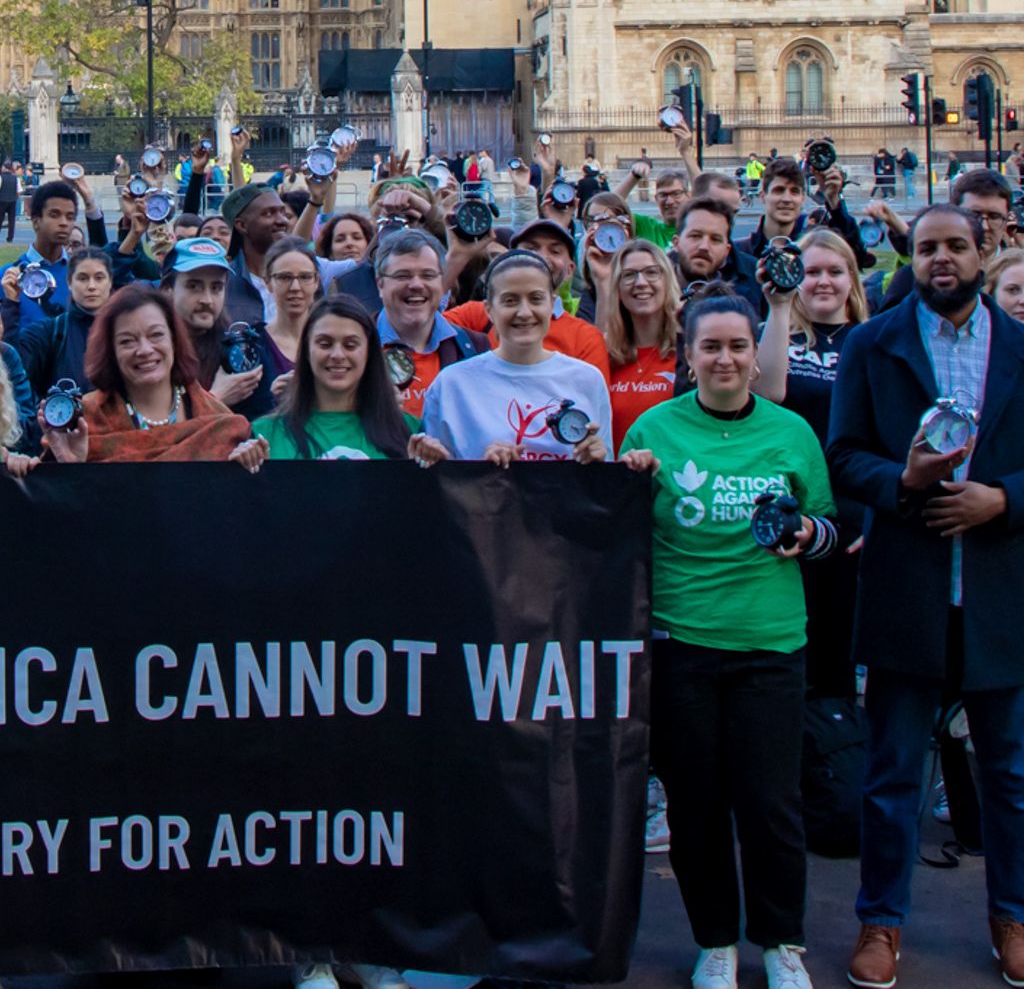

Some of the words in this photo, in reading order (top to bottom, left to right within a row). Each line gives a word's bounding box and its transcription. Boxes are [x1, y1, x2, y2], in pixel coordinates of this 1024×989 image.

[787, 345, 839, 368] CAF
[610, 381, 630, 392] rld
[631, 381, 668, 392] Vision
[711, 474, 785, 491] ACTION
[711, 505, 756, 522] HUN
[136, 640, 438, 720] CANNOT
[464, 640, 644, 722] WAIT
[89, 816, 190, 872] FOR
[208, 811, 405, 868] ACTION
